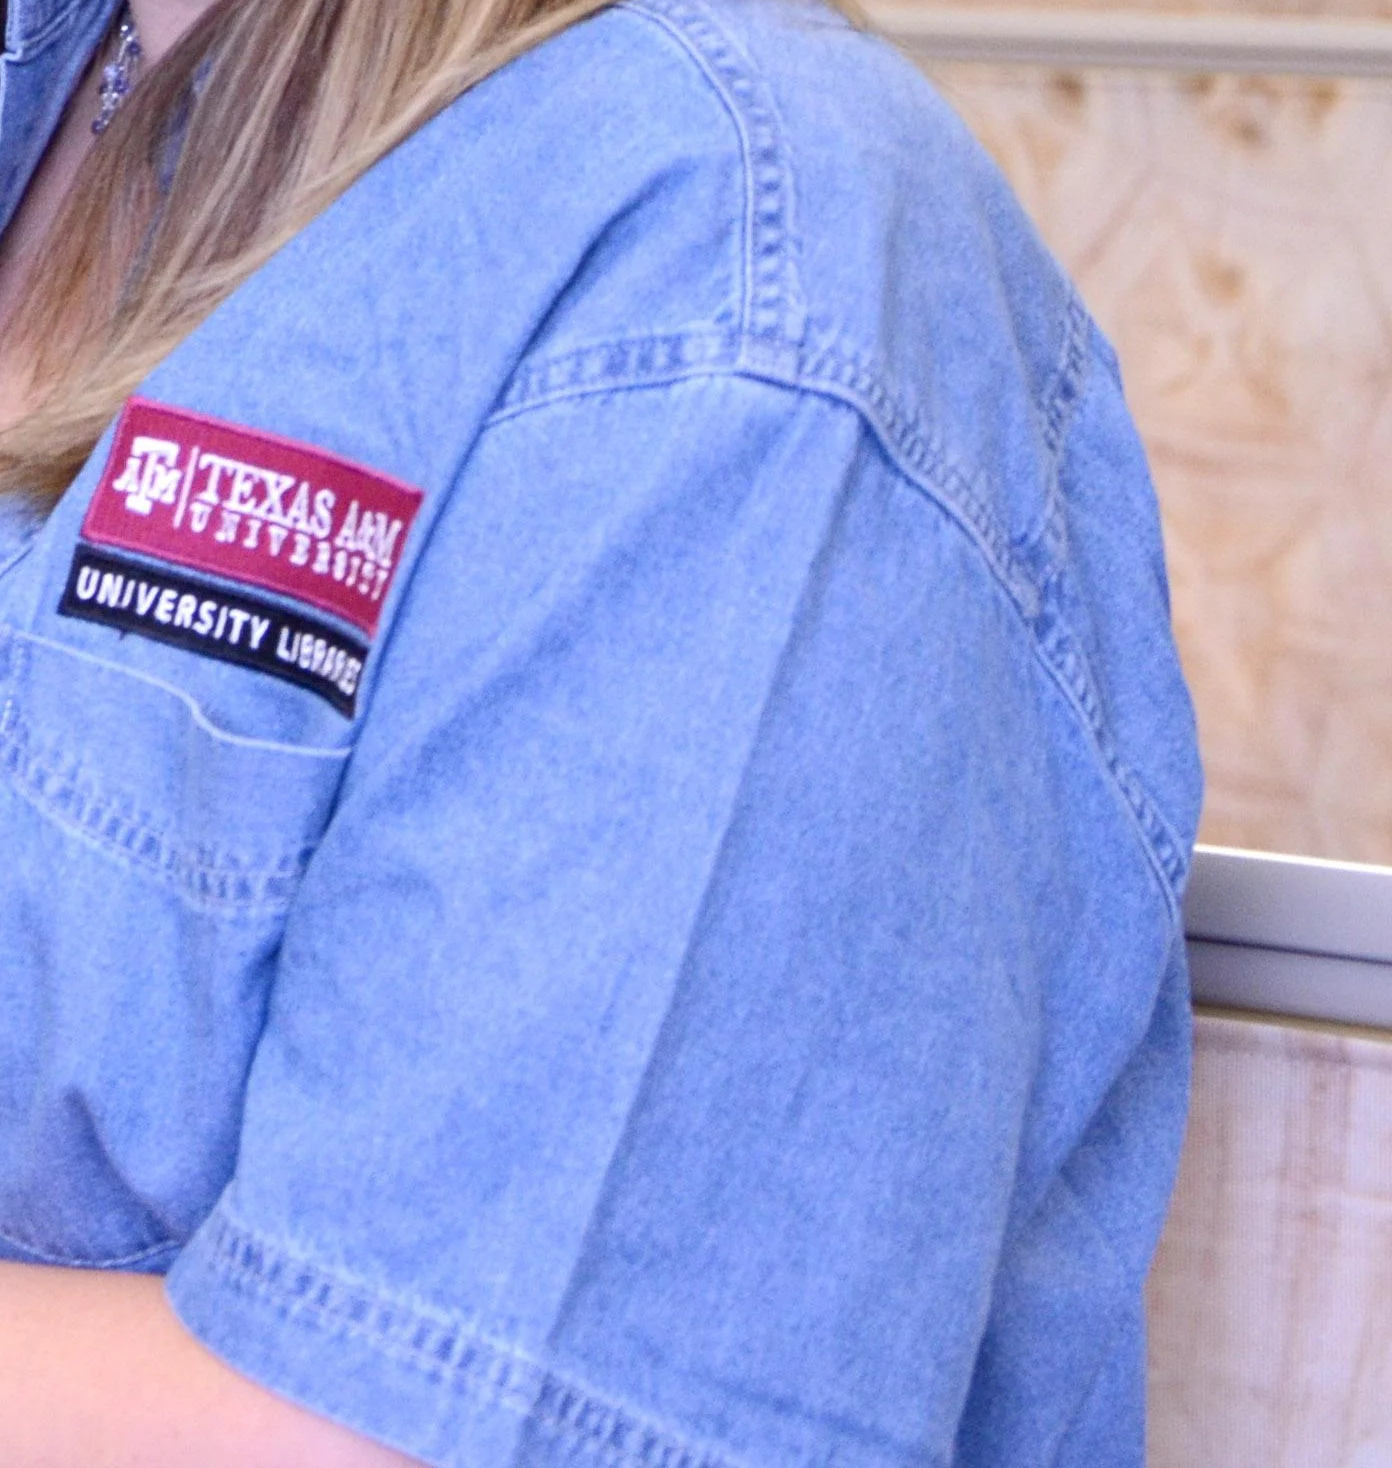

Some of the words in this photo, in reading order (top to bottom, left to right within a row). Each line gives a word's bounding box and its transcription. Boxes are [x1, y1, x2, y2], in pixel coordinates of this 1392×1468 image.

[190, 501, 390, 601] UNIVERSITY
[199, 453, 336, 540] TEXAS
[335, 499, 403, 569] A&M
[75, 566, 271, 650] UNIVERSITY
